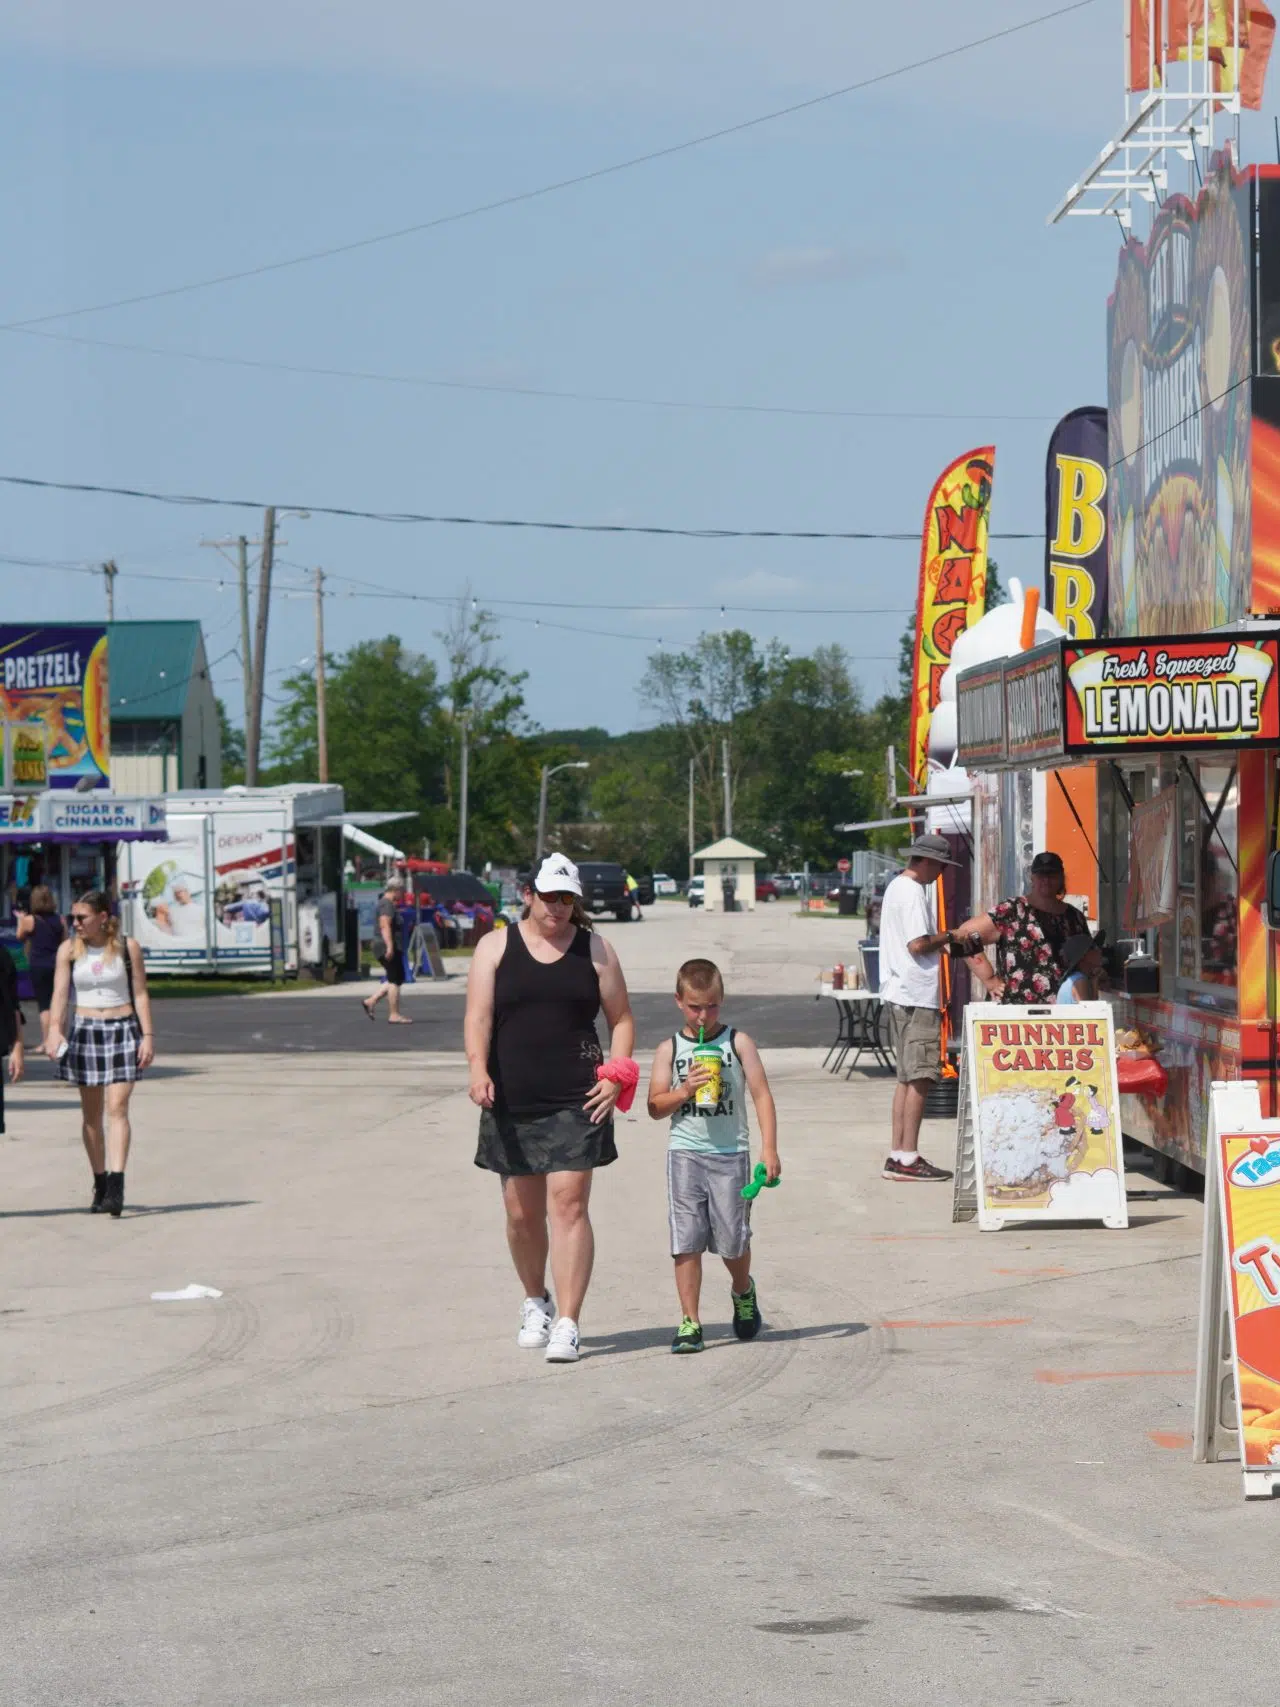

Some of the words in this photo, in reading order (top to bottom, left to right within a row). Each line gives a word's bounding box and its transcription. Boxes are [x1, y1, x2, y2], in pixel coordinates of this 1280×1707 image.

[4, 652, 81, 690] PRETZELS
[1101, 656, 1149, 681] Fresh
[1153, 646, 1236, 682] Squeezed
[1084, 680, 1261, 740] LEMONADE
[66, 804, 110, 816] SUGAR
[55, 815, 135, 829] CINNAMON
[980, 1023, 1103, 1046] FUNNEL
[992, 1048, 1094, 1071] CAKES
